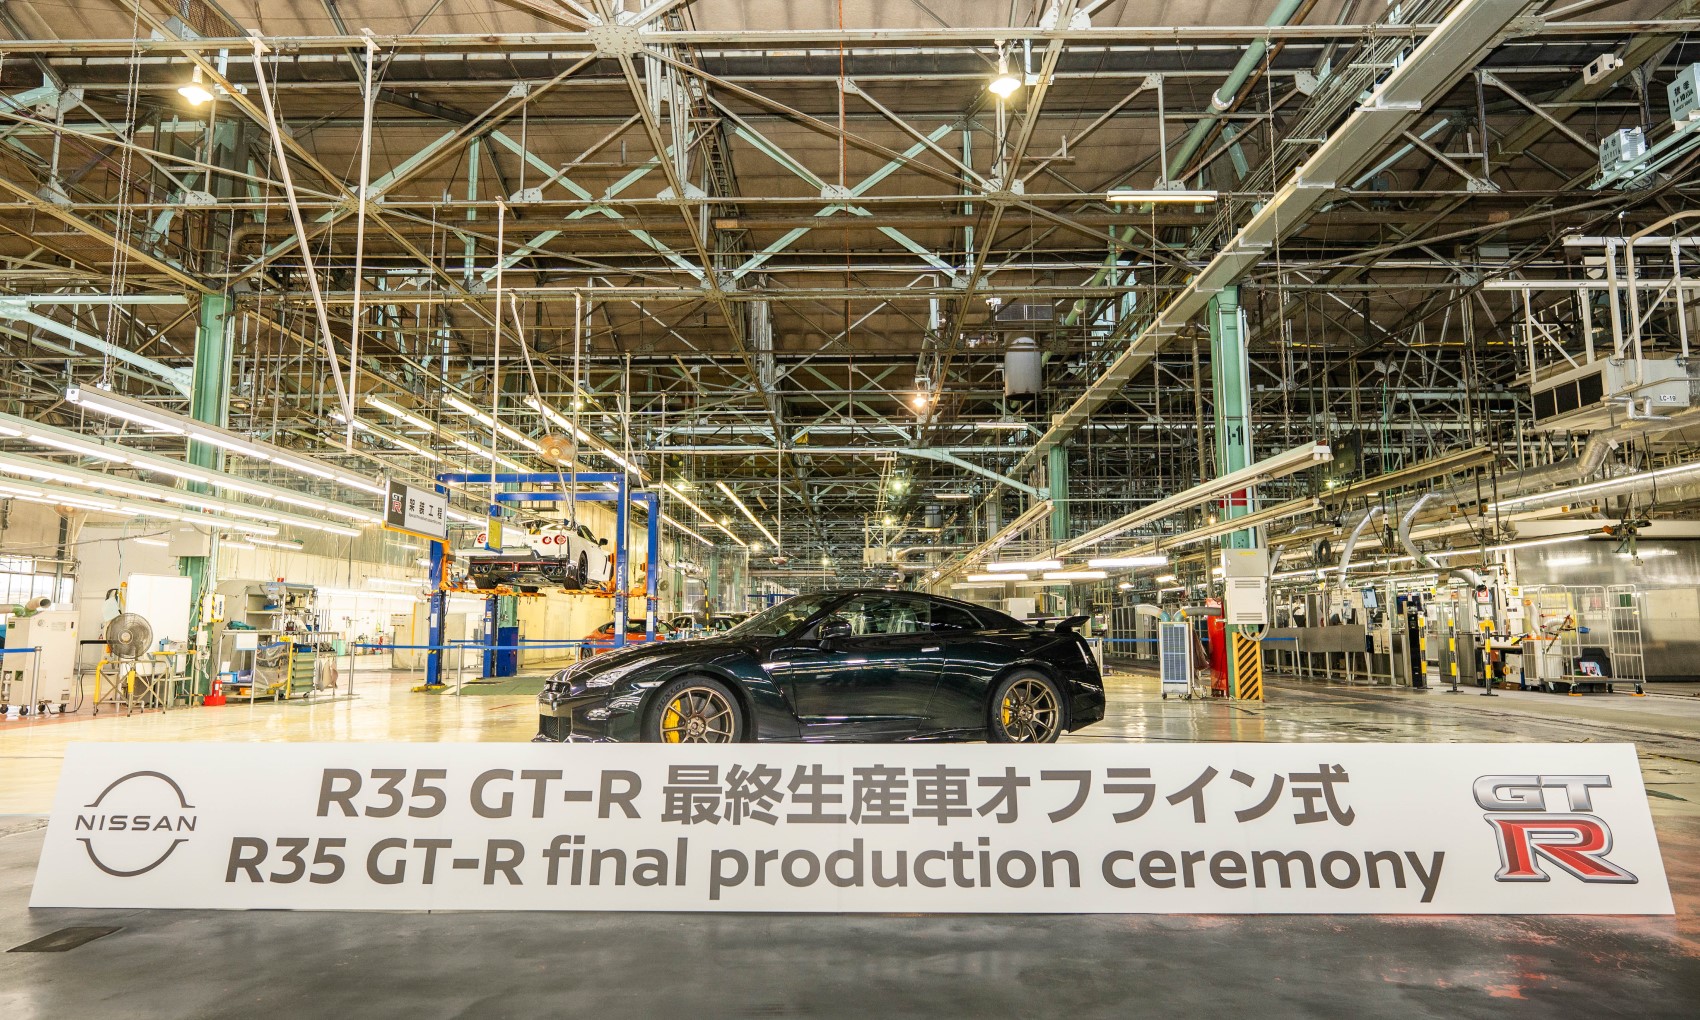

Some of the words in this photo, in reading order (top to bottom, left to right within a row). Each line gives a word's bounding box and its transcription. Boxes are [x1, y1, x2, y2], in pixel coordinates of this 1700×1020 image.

[656, 681, 688, 711] DUNLOP
[317, 769, 446, 818] R35
[471, 769, 641, 818] GT-R
[662, 764, 1355, 826] 最終生産車オフライン式
[1472, 774, 1612, 812] GT
[76, 814, 197, 832] NISSAN
[225, 837, 346, 884] R35
[367, 838, 524, 885] GT-R
[543, 835, 688, 886] final
[710, 837, 1080, 900] production
[1102, 850, 1445, 903] ceremony
[1483, 812, 1639, 885] R
